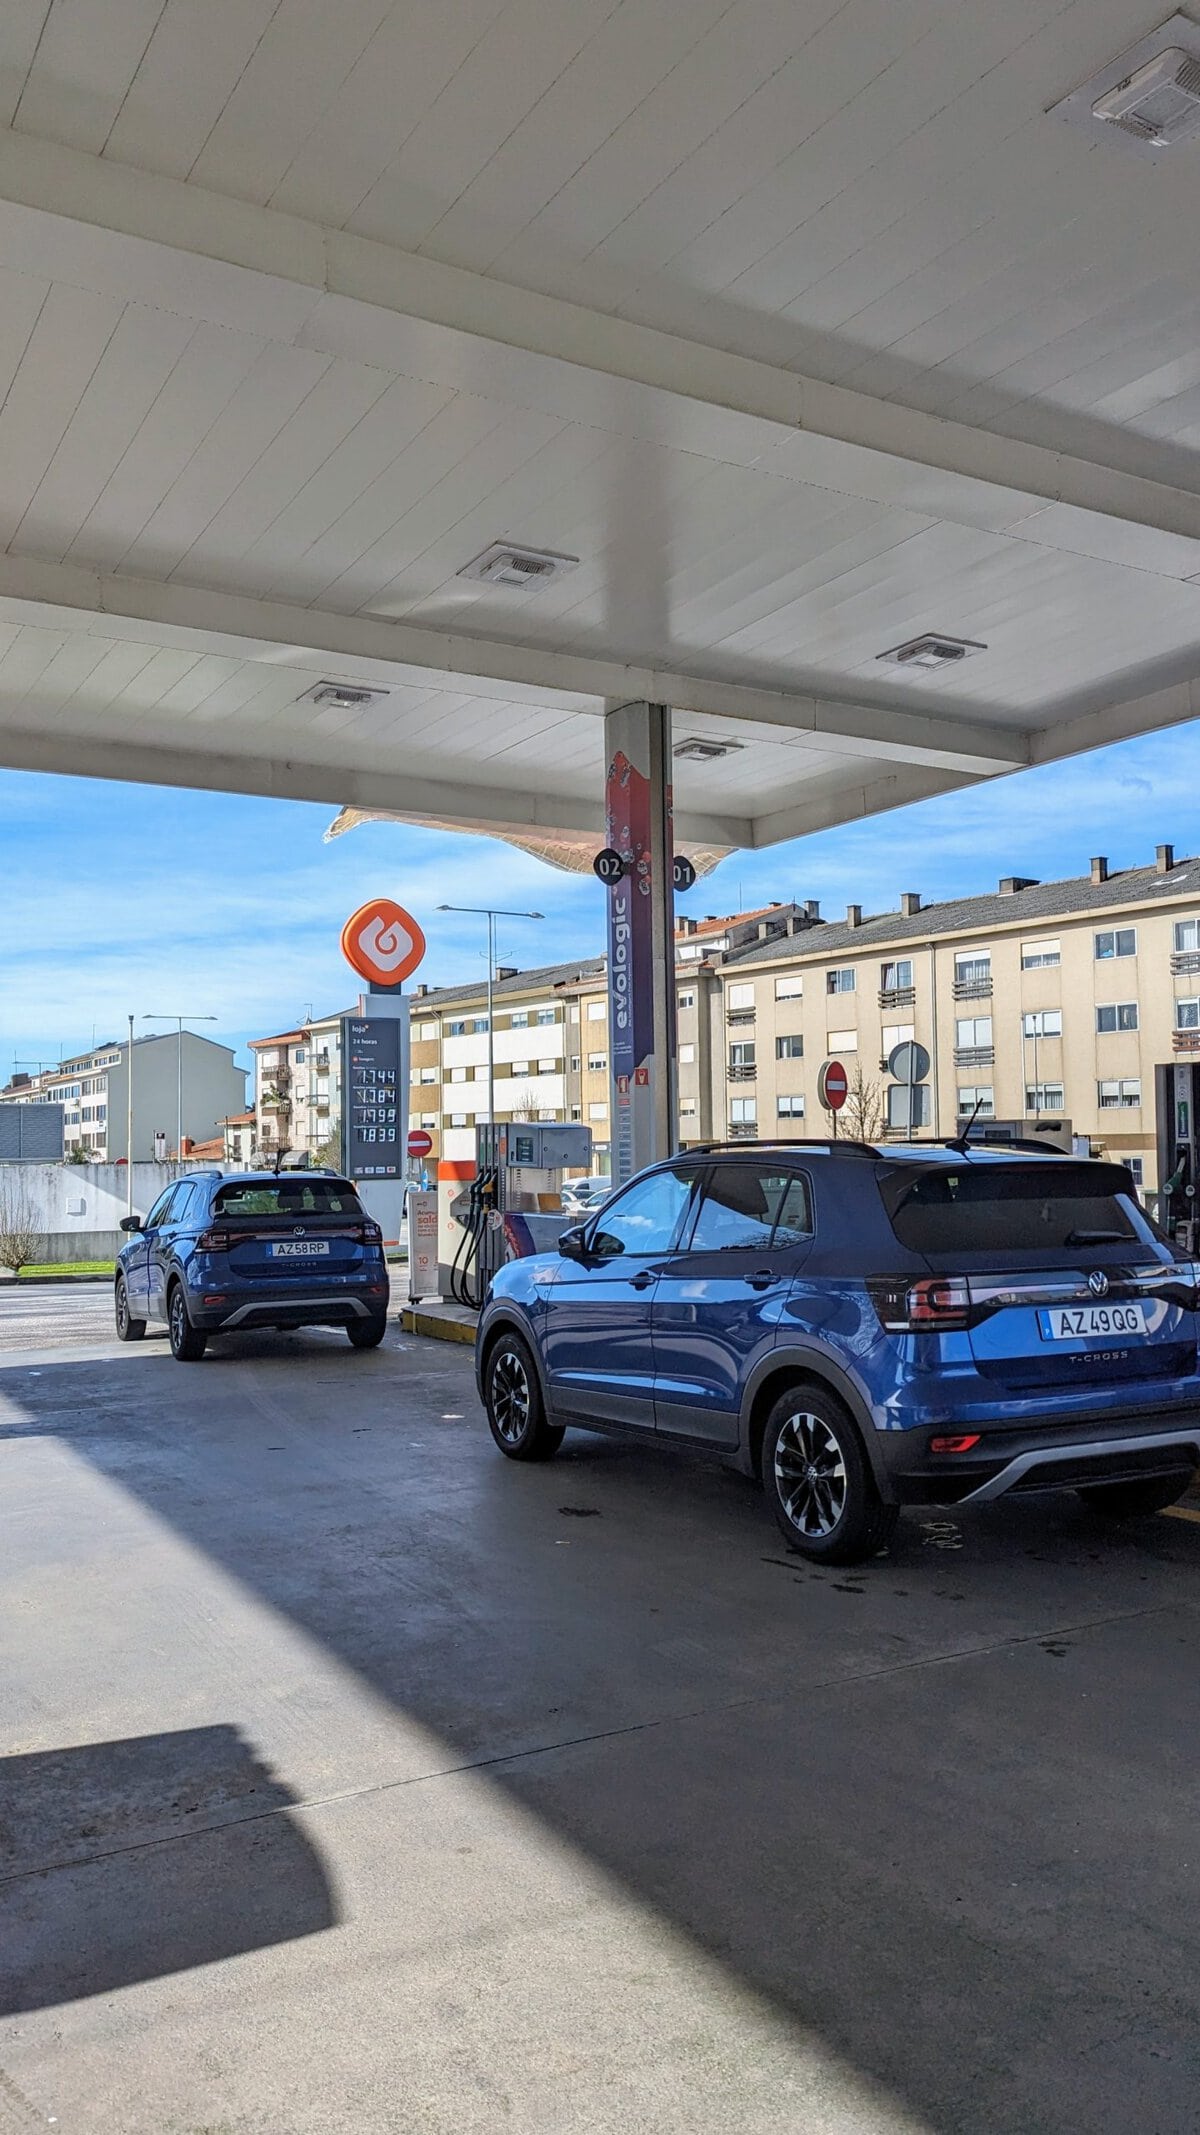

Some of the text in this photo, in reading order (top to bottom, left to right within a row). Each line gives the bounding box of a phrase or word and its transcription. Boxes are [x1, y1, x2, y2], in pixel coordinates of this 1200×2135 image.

[600, 858, 621, 876] 02
[673, 865, 691, 883] 01
[612, 897, 630, 1029] evologic
[352, 1025, 366, 1034] loja
[363, 1070, 395, 1083] 1.744
[363, 1109, 396, 1123] 1.799
[363, 1128, 396, 1142] 1.839
[418, 1215, 438, 1224] sald
[1069, 1350, 1128, 1363] T-CROSS
